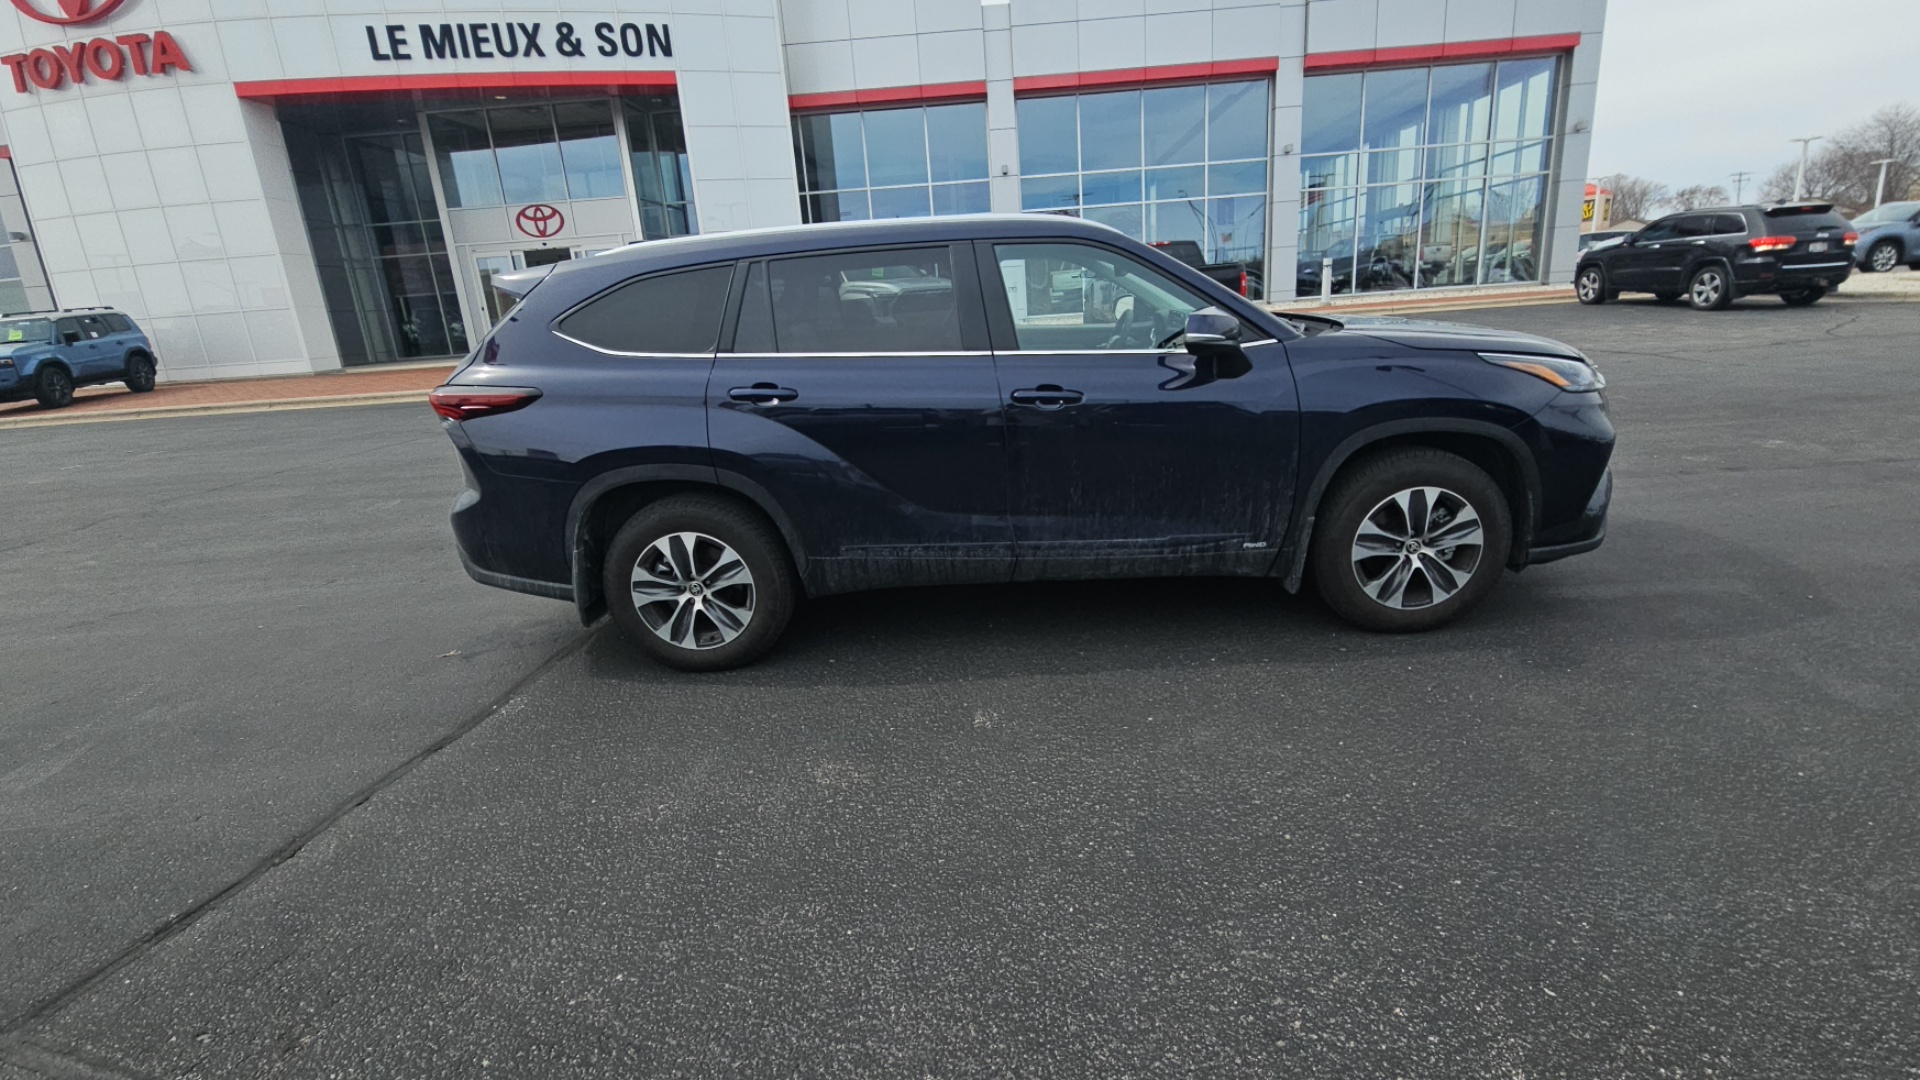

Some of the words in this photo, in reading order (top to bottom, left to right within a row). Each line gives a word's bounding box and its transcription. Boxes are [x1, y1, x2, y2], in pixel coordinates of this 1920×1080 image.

[365, 25, 412, 61] LE
[418, 23, 546, 60] MIEUX
[555, 22, 586, 58] &
[594, 22, 674, 58] SON
[0, 31, 192, 94] TOYOTA
[1243, 541, 1268, 549] AWD
